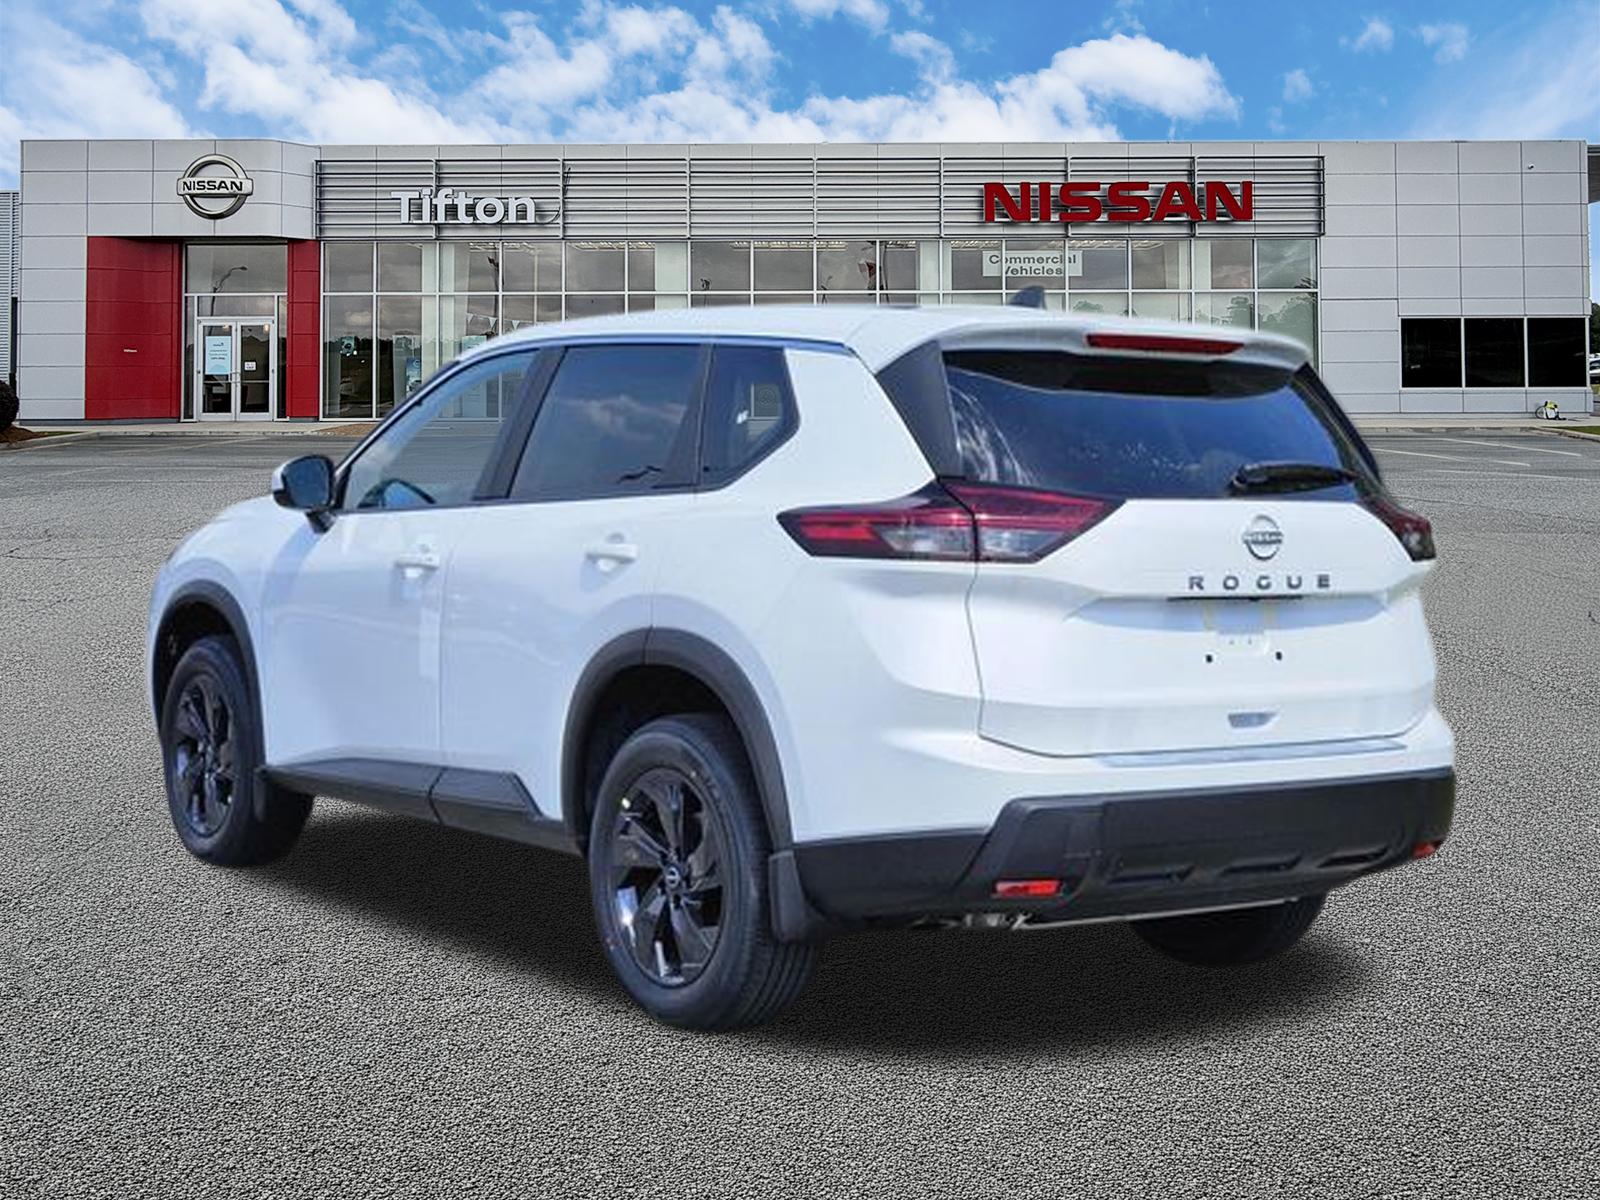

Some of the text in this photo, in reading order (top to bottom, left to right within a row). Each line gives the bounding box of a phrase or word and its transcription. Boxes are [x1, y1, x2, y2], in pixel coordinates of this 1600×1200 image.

[182, 180, 244, 192] NISSAN
[390, 187, 536, 224] Tifton
[983, 181, 1254, 223] NISSAN
[1188, 574, 1331, 591] ROGUE
